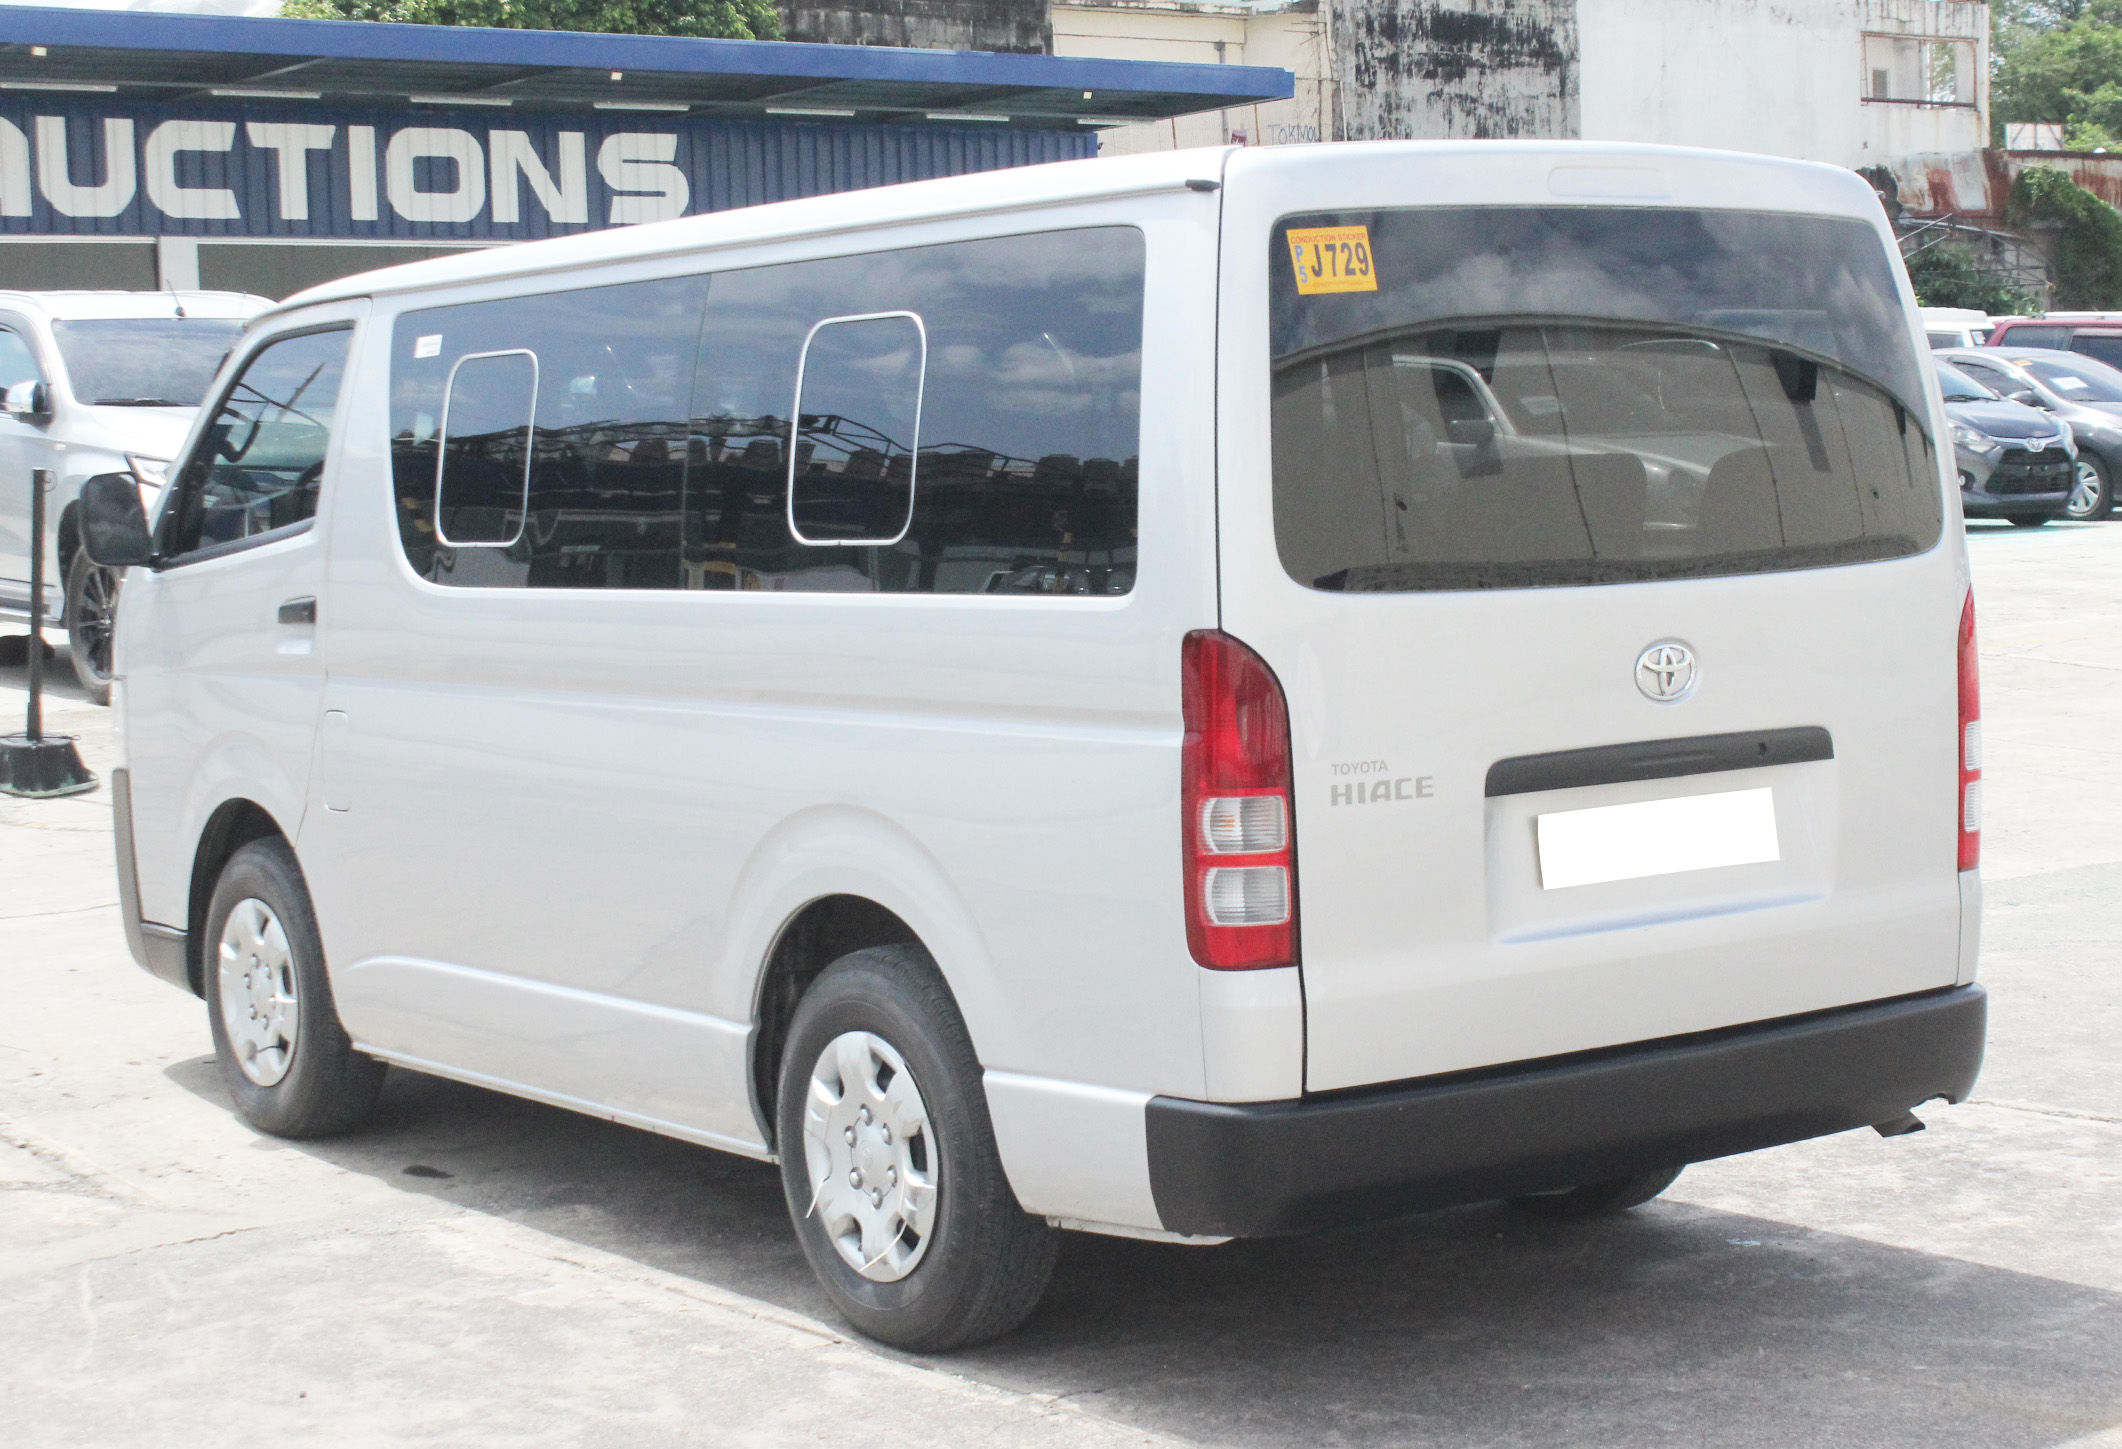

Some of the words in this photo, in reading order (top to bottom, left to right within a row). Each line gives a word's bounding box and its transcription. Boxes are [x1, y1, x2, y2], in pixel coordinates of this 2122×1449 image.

[1311, 242, 1369, 277] J729
[1331, 760, 1388, 776] TOYOTA
[1330, 776, 1434, 806] HIACE
